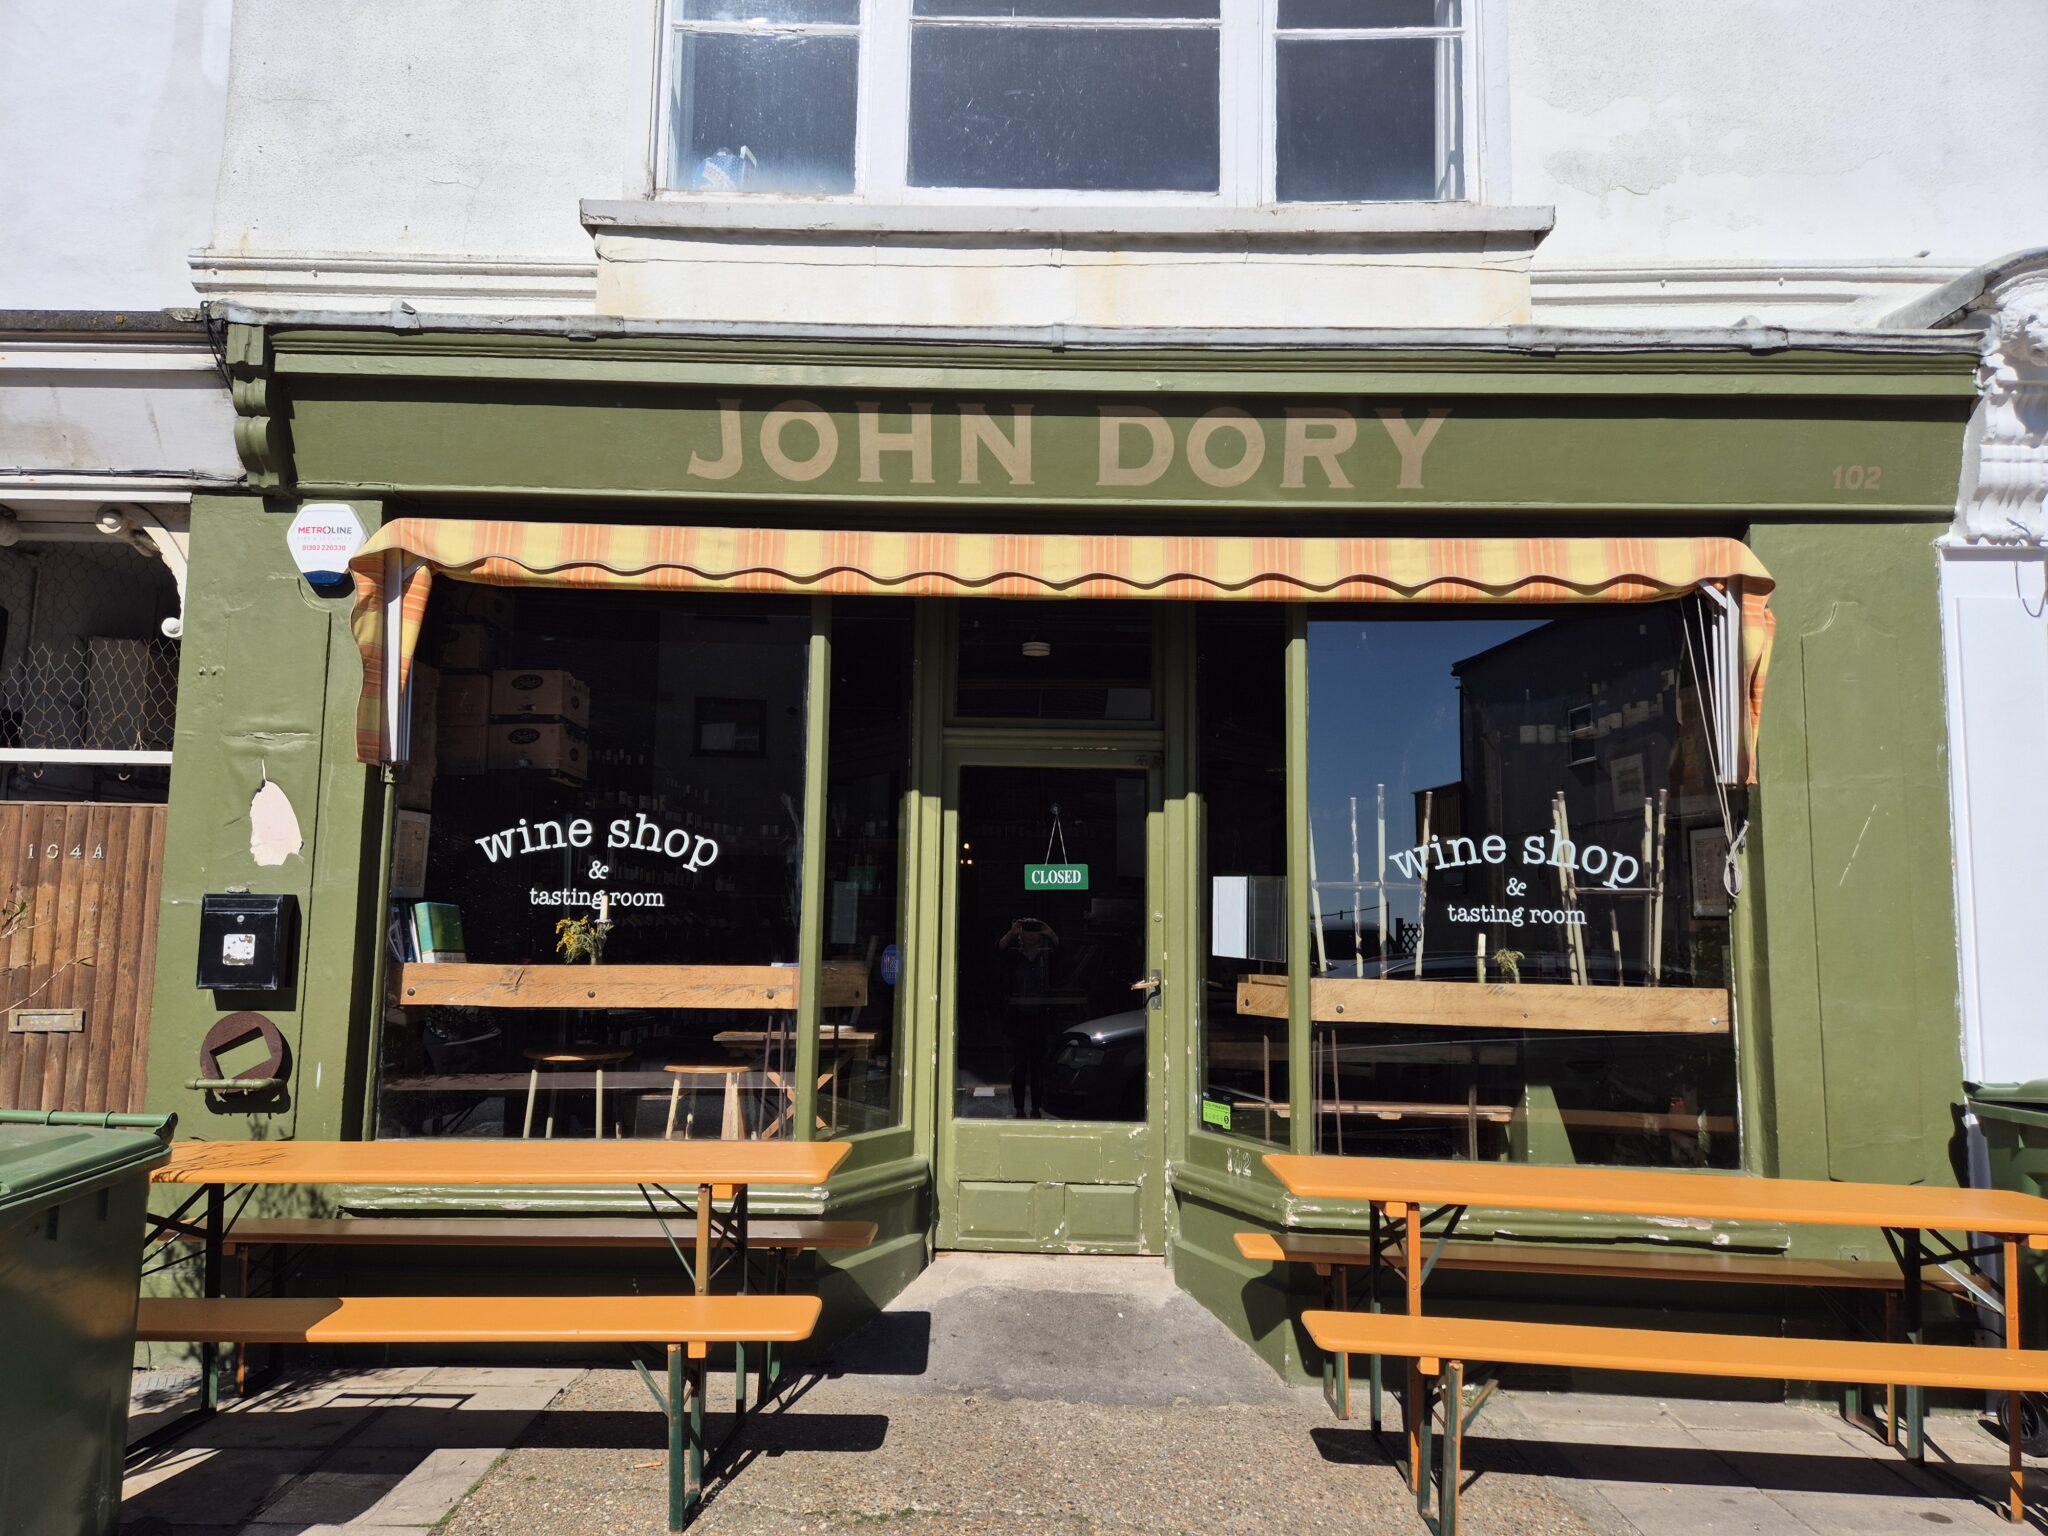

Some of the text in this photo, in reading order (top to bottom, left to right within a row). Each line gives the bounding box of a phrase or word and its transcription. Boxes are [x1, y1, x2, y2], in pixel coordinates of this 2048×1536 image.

[686, 398, 1453, 490] JOHN DORY
[1832, 464, 1882, 491] 102
[298, 526, 353, 534] METROLINE
[27, 843, 104, 859] 104A
[475, 818, 592, 863] wine
[607, 813, 719, 873] shop
[588, 860, 609, 880] &
[1388, 834, 1507, 879] wine
[1523, 829, 1639, 889] shop
[1031, 869, 1082, 885] CLOSED
[1506, 877, 1527, 897] &
[529, 887, 665, 910] tasting room
[1447, 903, 1587, 927] tasting room
